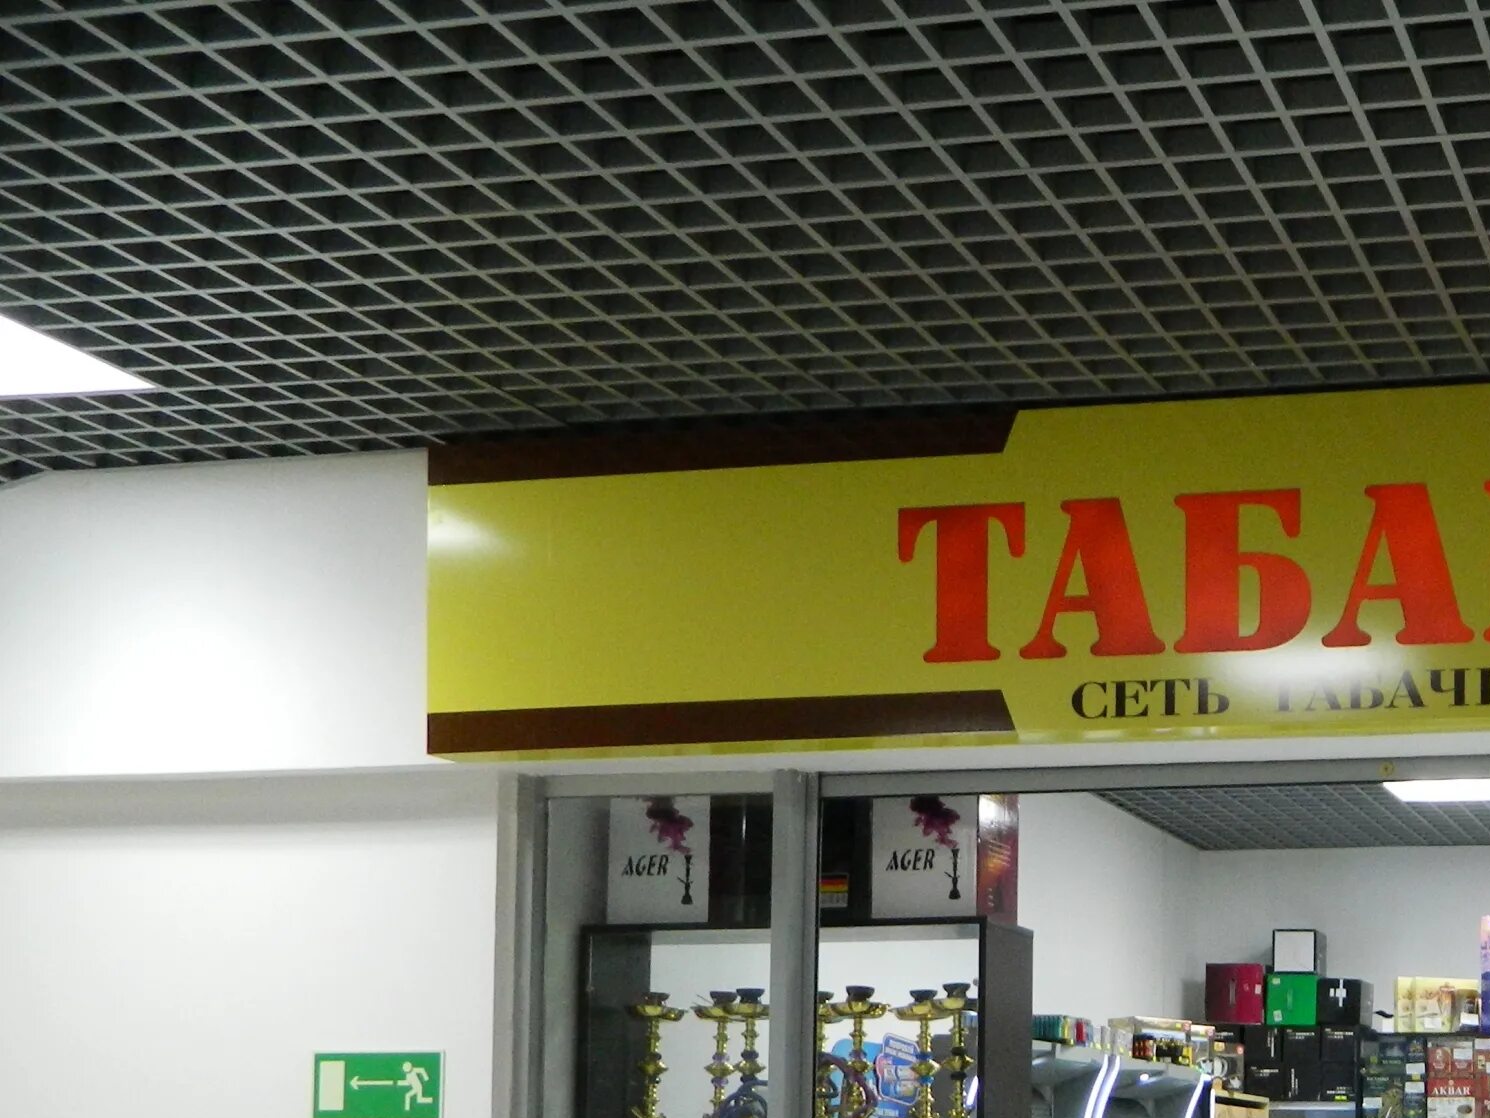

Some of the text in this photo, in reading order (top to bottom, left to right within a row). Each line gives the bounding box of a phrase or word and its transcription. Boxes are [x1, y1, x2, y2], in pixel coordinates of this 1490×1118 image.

[1071, 678, 1231, 720] СЕТЬ
[621, 854, 669, 877] AGER
[886, 848, 935, 872] AGER
[1431, 1085, 1472, 1096] AKBAR
